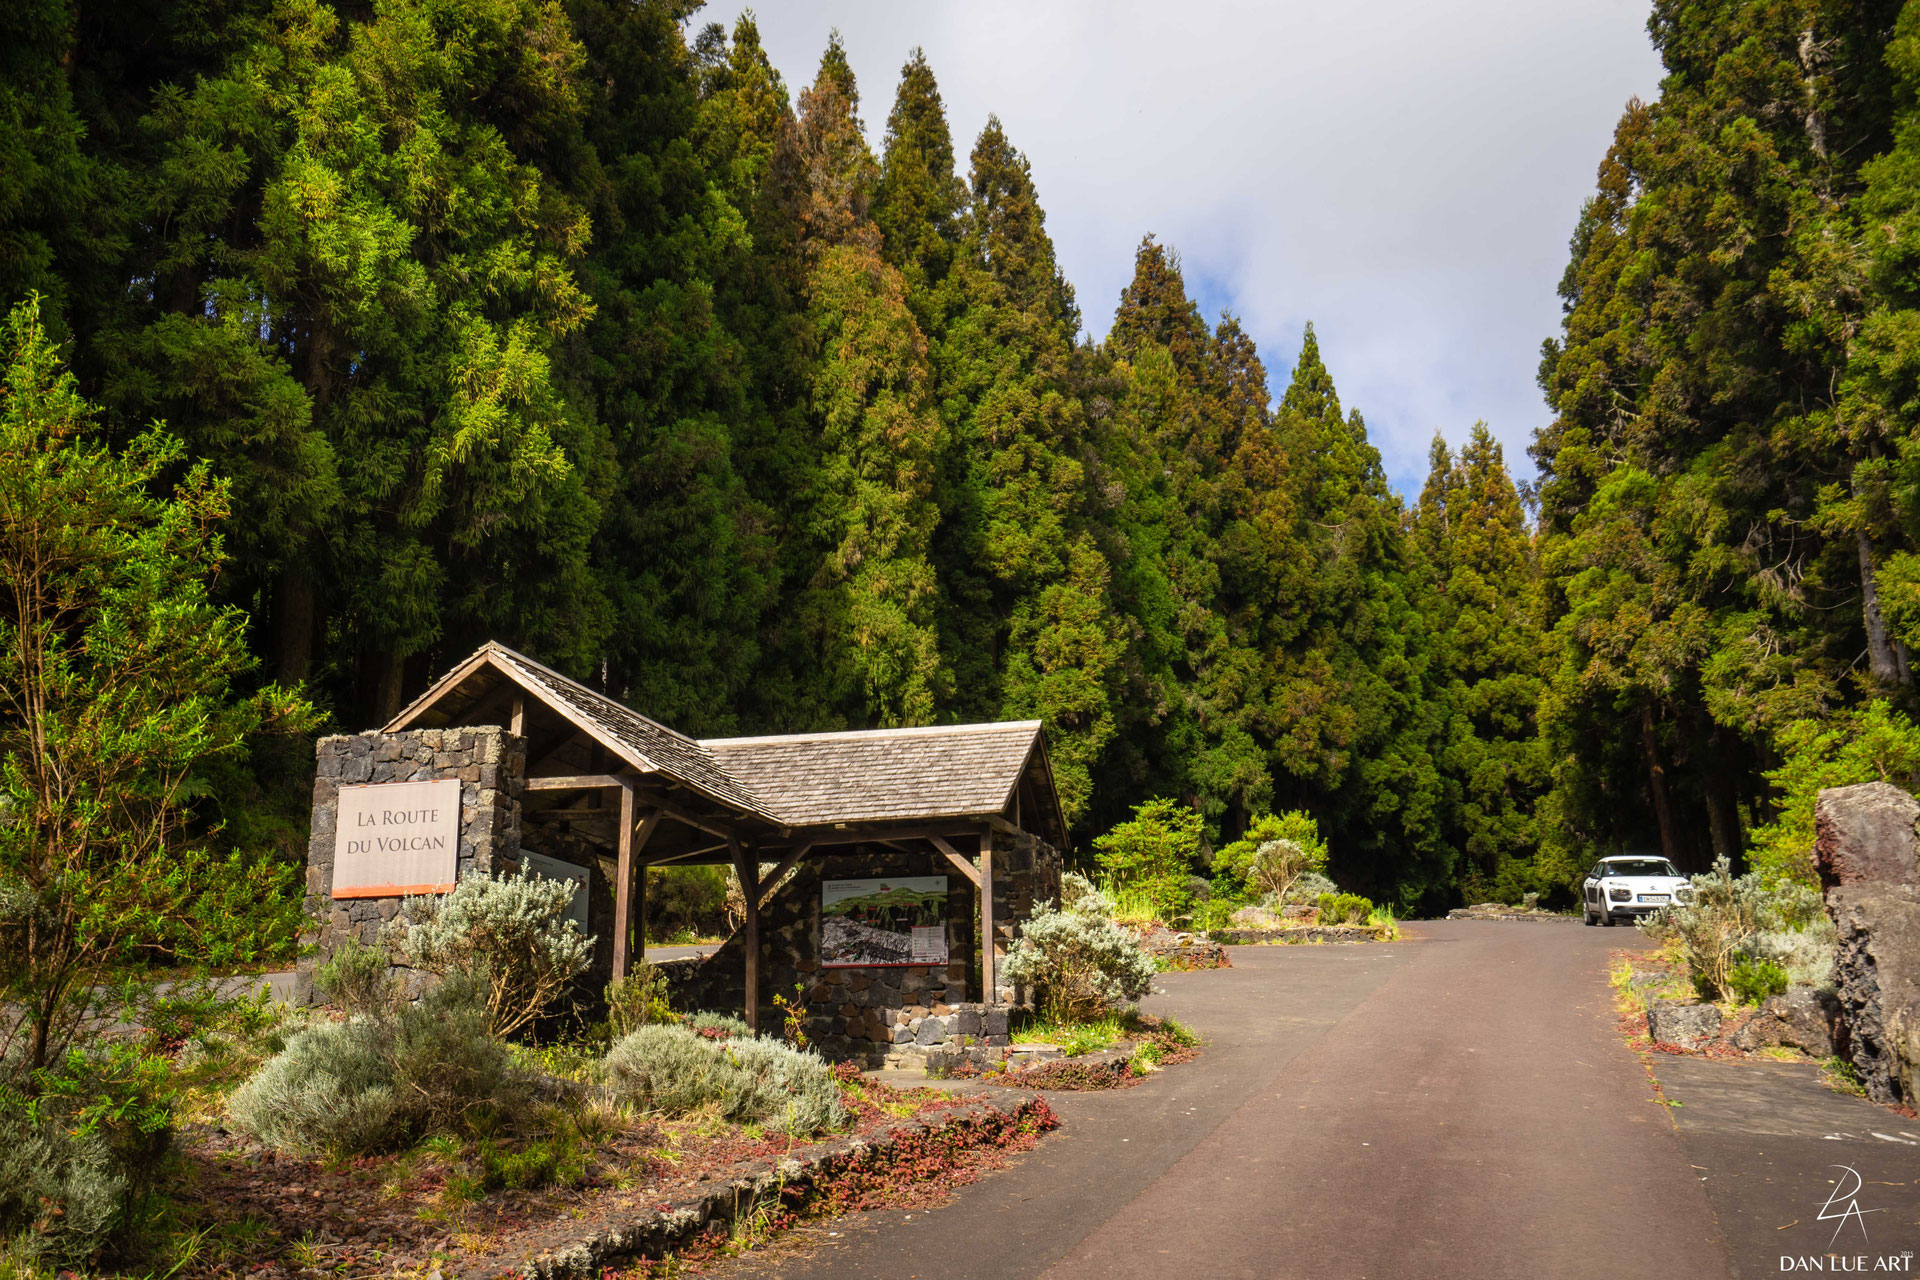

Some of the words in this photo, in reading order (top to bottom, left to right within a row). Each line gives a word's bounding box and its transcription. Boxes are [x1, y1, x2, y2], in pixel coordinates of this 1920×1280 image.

[357, 812, 376, 827] LA
[382, 809, 439, 826] ROUTE
[347, 840, 371, 854] DU
[377, 835, 445, 852] VOLCAN
